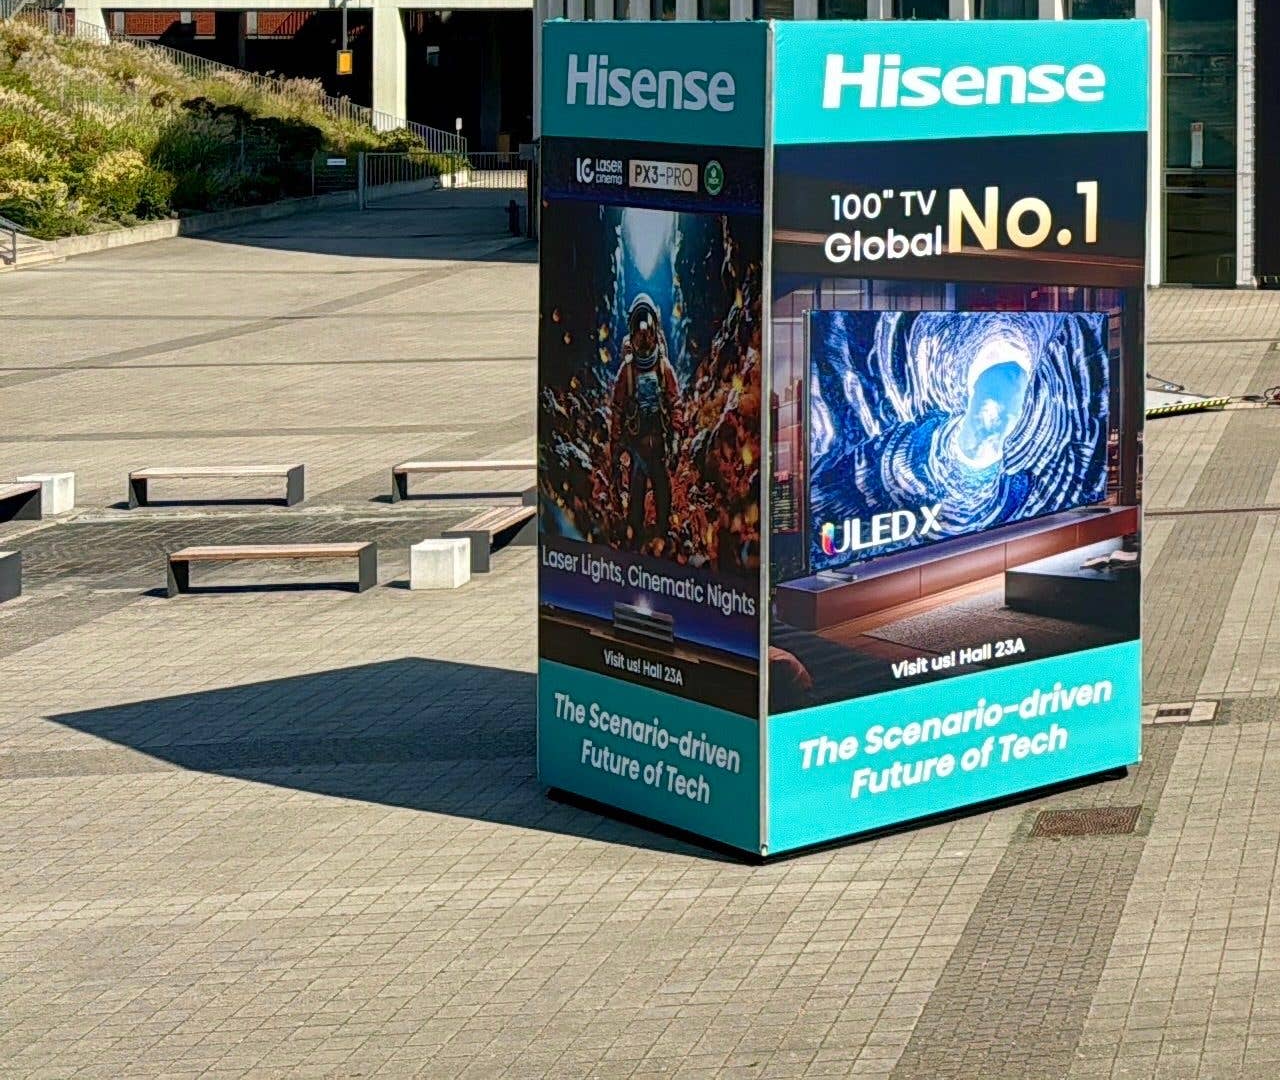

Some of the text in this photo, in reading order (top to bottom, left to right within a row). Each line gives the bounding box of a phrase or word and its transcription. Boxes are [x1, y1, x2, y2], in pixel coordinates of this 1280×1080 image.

[566, 54, 735, 112] Hisense
[823, 54, 1106, 109] Hisense
[635, 164, 693, 188] PX3-PRO
[832, 189, 936, 220] 100" TV
[949, 180, 1098, 253] No.1
[824, 225, 942, 264] Global
[821, 503, 942, 556] ULED X
[542, 544, 756, 617] Laser Lights, Cinematic Nights
[603, 648, 683, 686] Visit us! Hall 23A
[891, 637, 1025, 679] Visit us! Hall 23A
[555, 692, 740, 774] The Scenario-driven
[799, 678, 1113, 770] The Scenario-driven
[581, 738, 711, 805] Future of Tech
[850, 723, 1069, 799] Future of Tech
